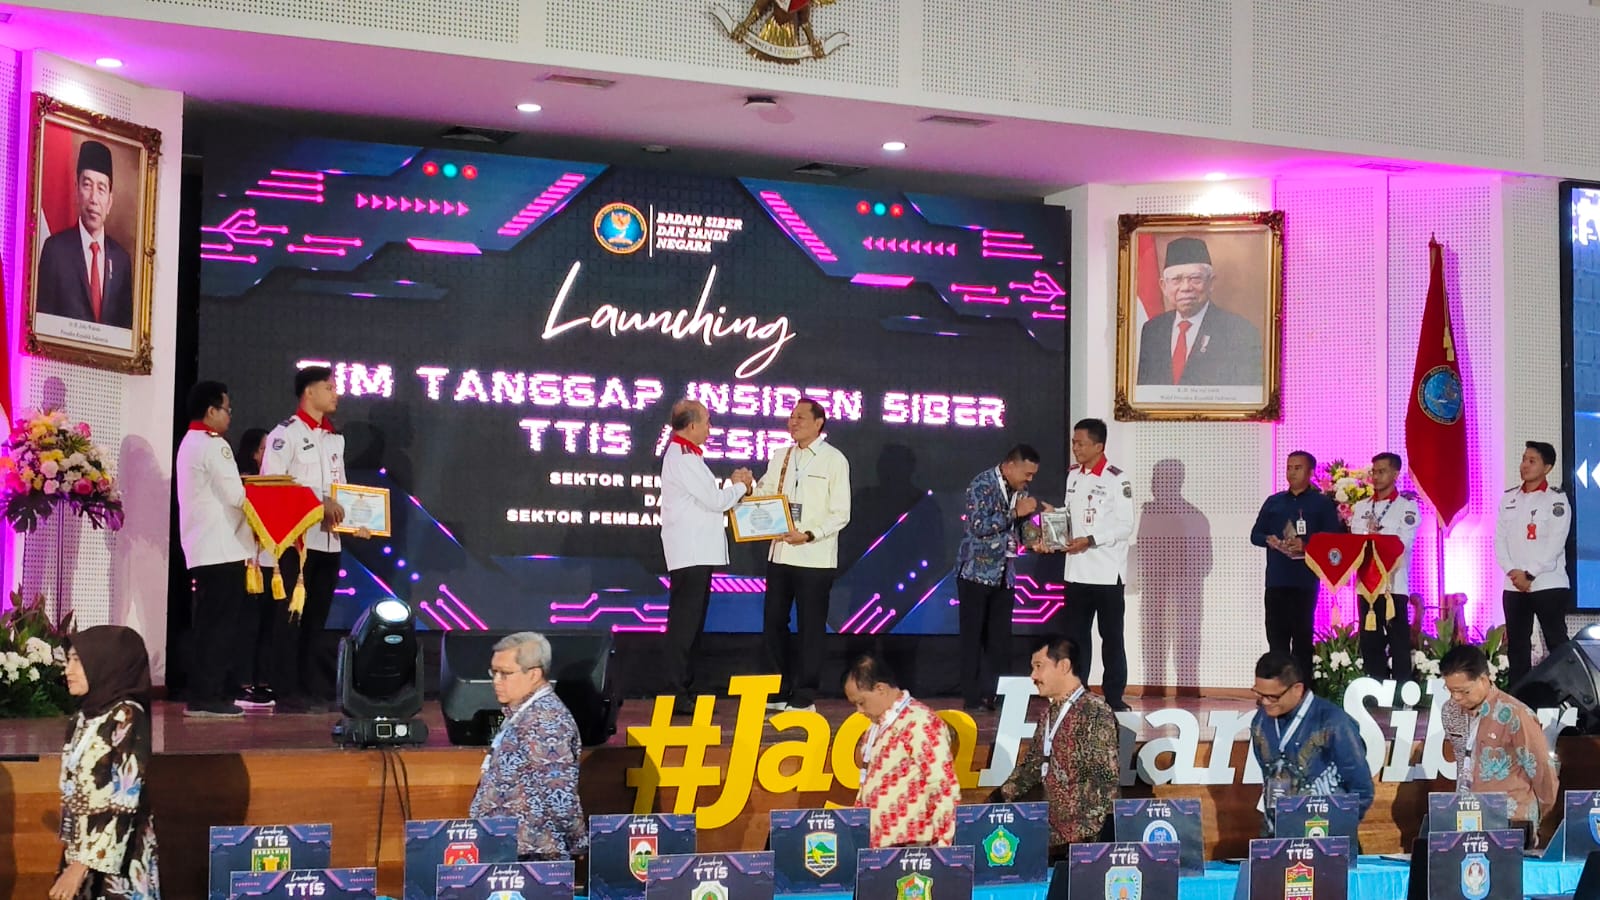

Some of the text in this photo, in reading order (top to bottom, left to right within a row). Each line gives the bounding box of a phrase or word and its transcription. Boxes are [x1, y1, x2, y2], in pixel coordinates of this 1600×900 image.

[656, 212, 703, 226] BADAN
[704, 216, 744, 231] SIBER
[656, 225, 730, 242] DAN SANDI
[656, 237, 712, 253] NEGARA
[541, 260, 797, 379] Launching
[416, 366, 664, 411] TANGGAP
[882, 391, 1006, 428] SIBER
[518, 418, 632, 455] TTIS
[549, 471, 625, 488] SEKTOR
[506, 509, 584, 524] SEKTOR
[1146, 807, 1172, 818] TTIS
[1305, 803, 1329, 813] TTIS
[1457, 801, 1481, 811] TTIS
[806, 818, 836, 830] TTIS
[988, 813, 1015, 824] TTIS
[445, 828, 478, 840] TTIS
[628, 823, 659, 835] TTIS
[254, 835, 289, 848] TTIS
[1462, 841, 1489, 853] TTIS
[1109, 852, 1140, 865] TTIS
[1285, 848, 1314, 861] TTIS
[899, 858, 932, 871] TTIS
[693, 866, 729, 881] TTIS
[487, 875, 526, 890] TTIS
[284, 882, 326, 897] TTIS
